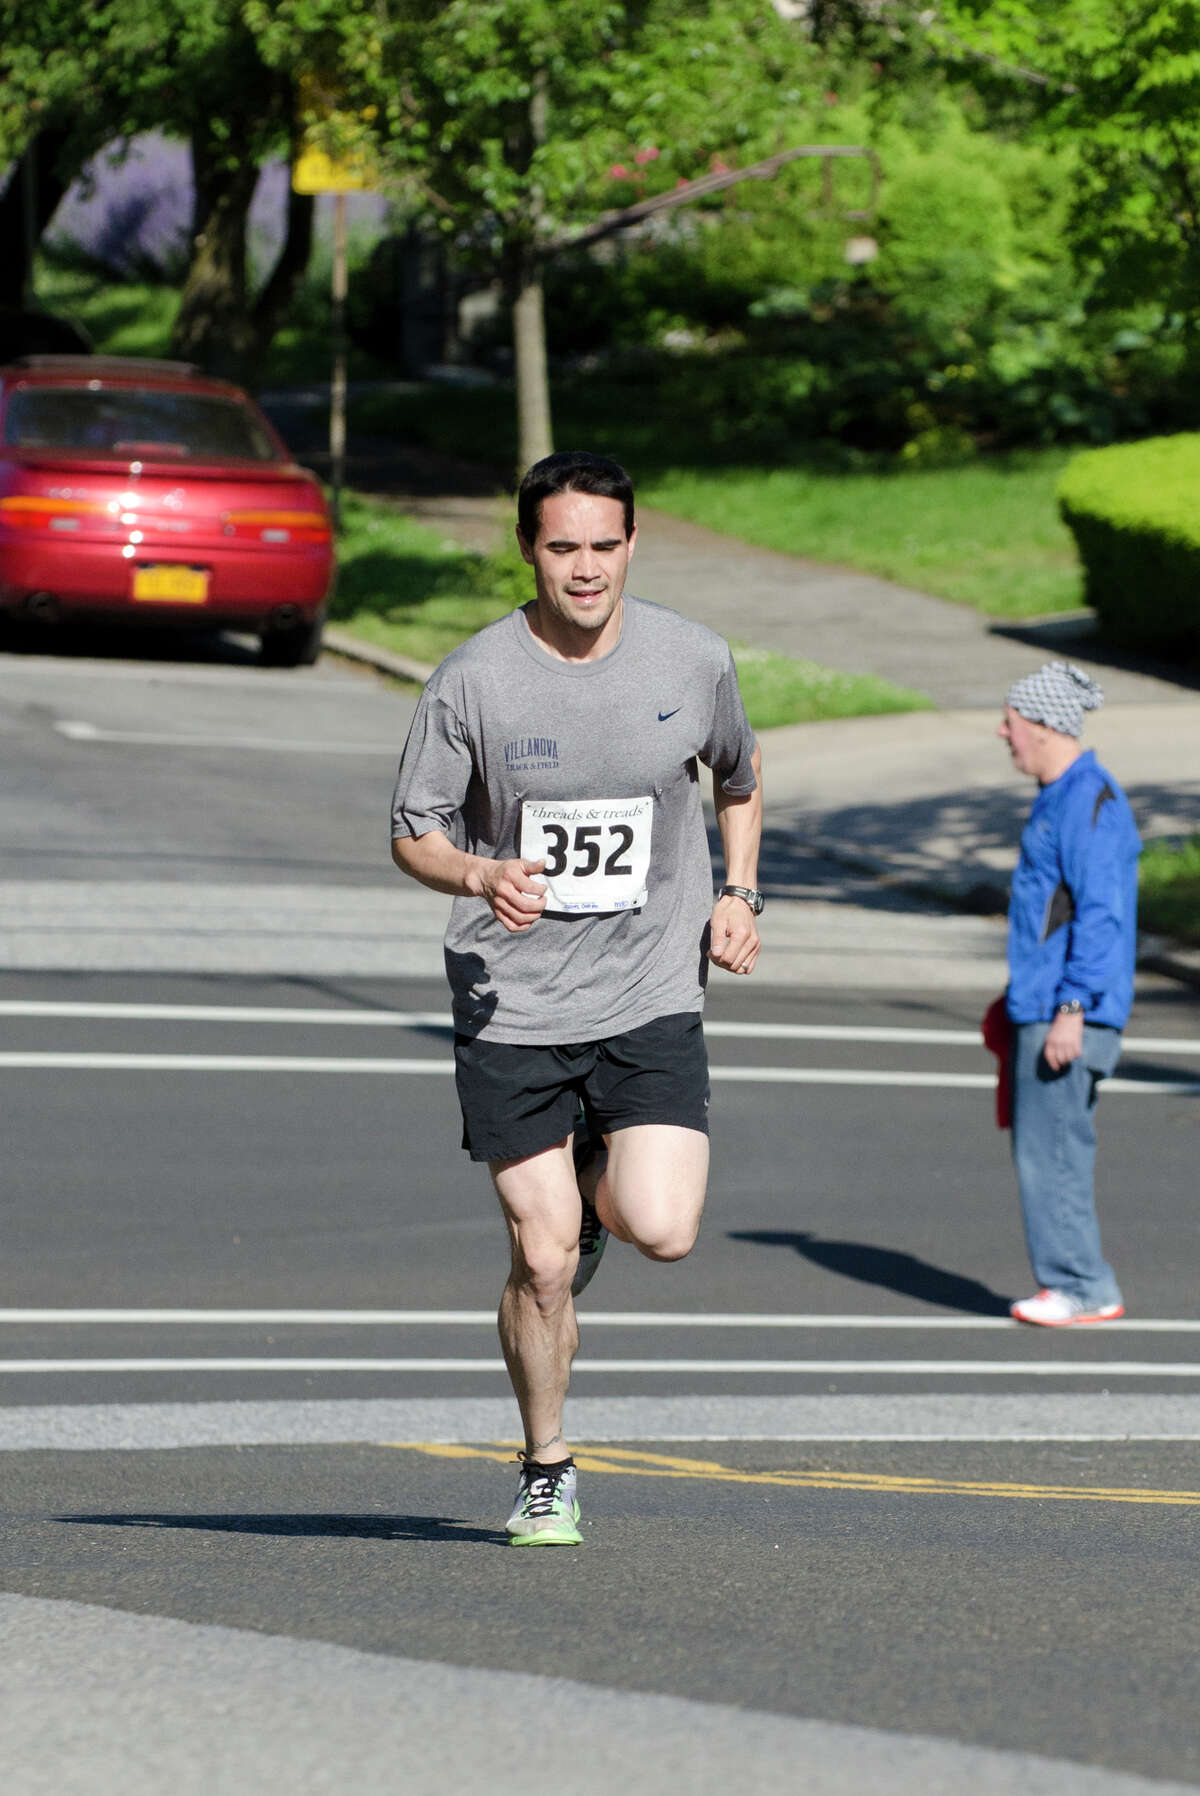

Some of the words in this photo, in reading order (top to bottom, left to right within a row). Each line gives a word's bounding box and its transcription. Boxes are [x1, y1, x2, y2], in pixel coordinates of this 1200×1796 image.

[504, 738, 559, 762] VILLANOVA
[532, 808, 583, 820] threads
[585, 809, 600, 819] &
[603, 805, 643, 818] treads
[541, 824, 634, 877] 352
